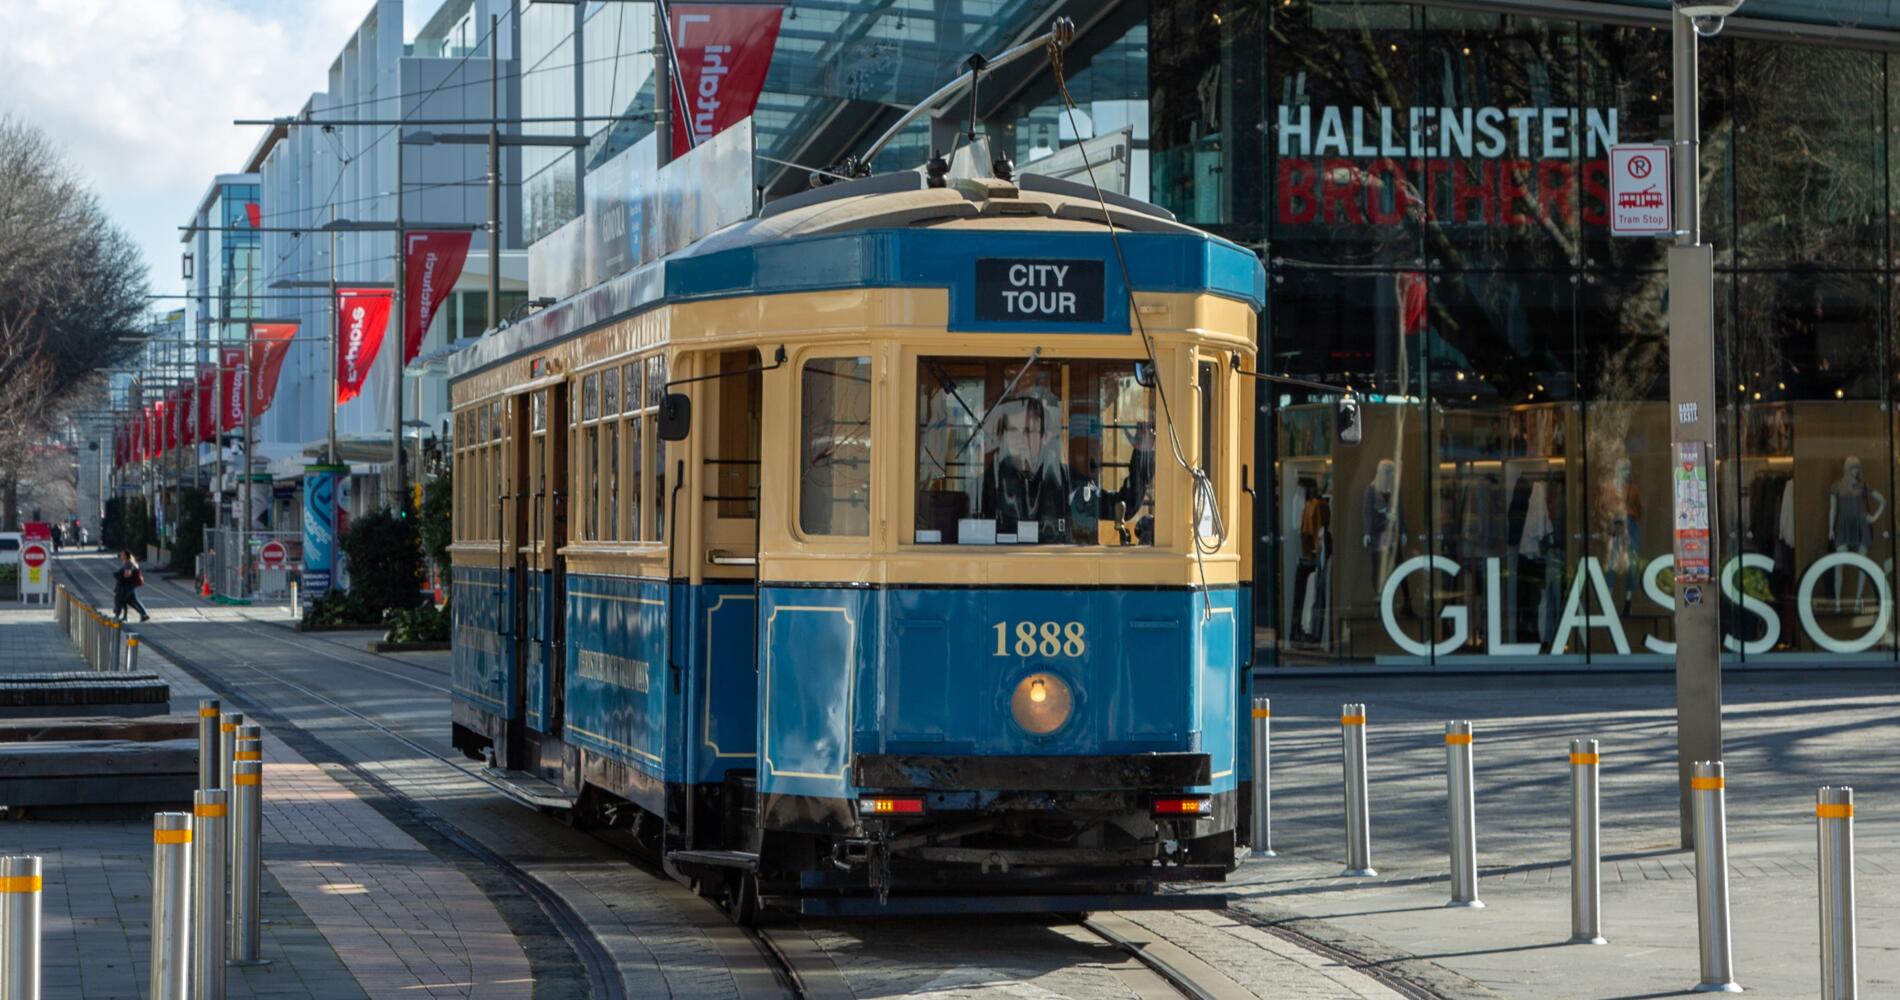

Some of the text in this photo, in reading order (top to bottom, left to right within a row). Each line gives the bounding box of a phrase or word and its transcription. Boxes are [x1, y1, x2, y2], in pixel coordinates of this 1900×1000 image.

[1278, 105, 1618, 158] HALLENSTEIN
[1276, 159, 1611, 225] BROTHERS
[1619, 214, 1664, 225] Tram Stop
[1009, 264, 1069, 287] CITY
[1002, 291, 1076, 314] TOUR
[1381, 552, 1893, 656] GLASSO
[992, 621, 1085, 657] 1888
